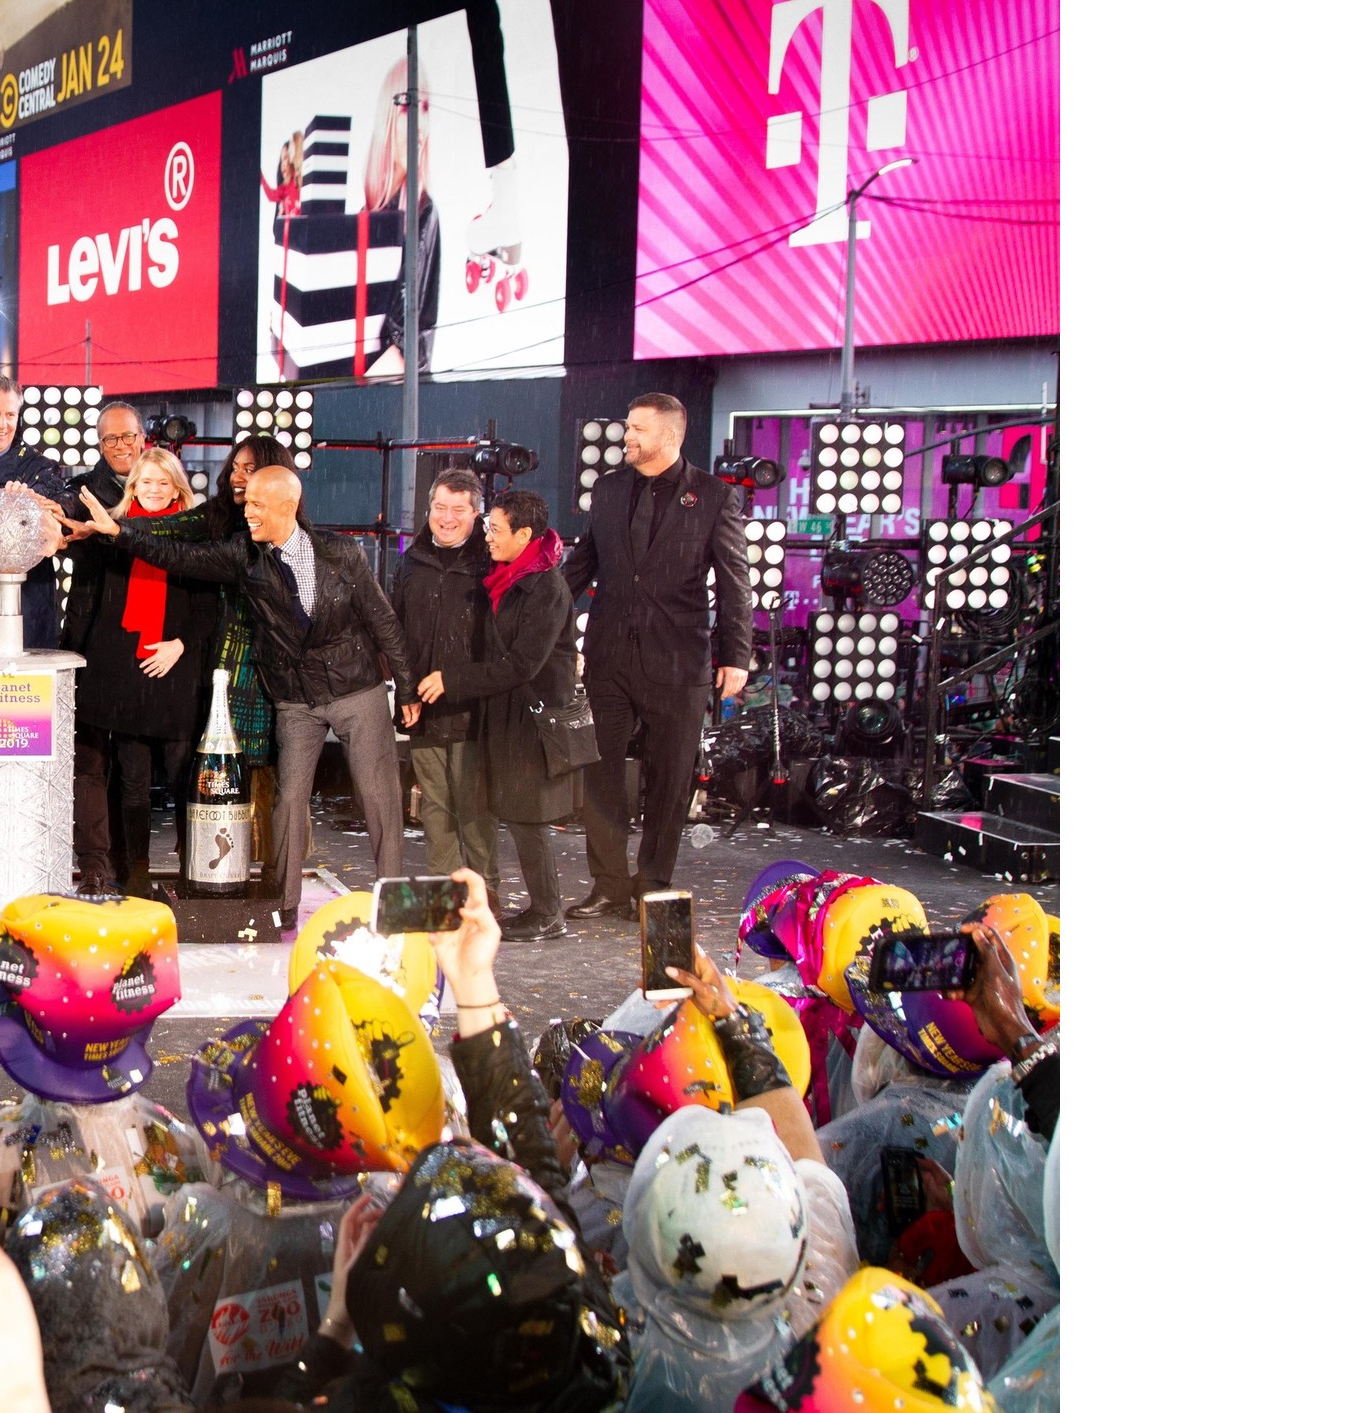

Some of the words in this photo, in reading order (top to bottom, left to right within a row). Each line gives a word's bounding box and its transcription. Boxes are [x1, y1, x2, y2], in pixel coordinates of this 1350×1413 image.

[250, 30, 293, 57] MARRIOTT
[57, 41, 92, 103] JAN
[97, 28, 124, 87] 24
[250, 48, 287, 72] MARQUIS
[18, 57, 56, 95] COMEDY
[18, 83, 56, 119] CENTRAL
[811, 521, 822, 532] 46
[211, 787, 240, 796] SQUARE
[112, 973, 145, 994] planet
[115, 983, 155, 1001] fitness
[925, 1021, 947, 1046] NEW
[84, 1051, 107, 1061] TIMES
[85, 1042, 109, 1052] NEW
[294, 1098, 324, 1150] fitness
[298, 1087, 326, 1139] planet
[245, 1092, 258, 1119] NEW
[281, 1146, 302, 1166] EVE
[250, 1125, 276, 1157] SQUARE
